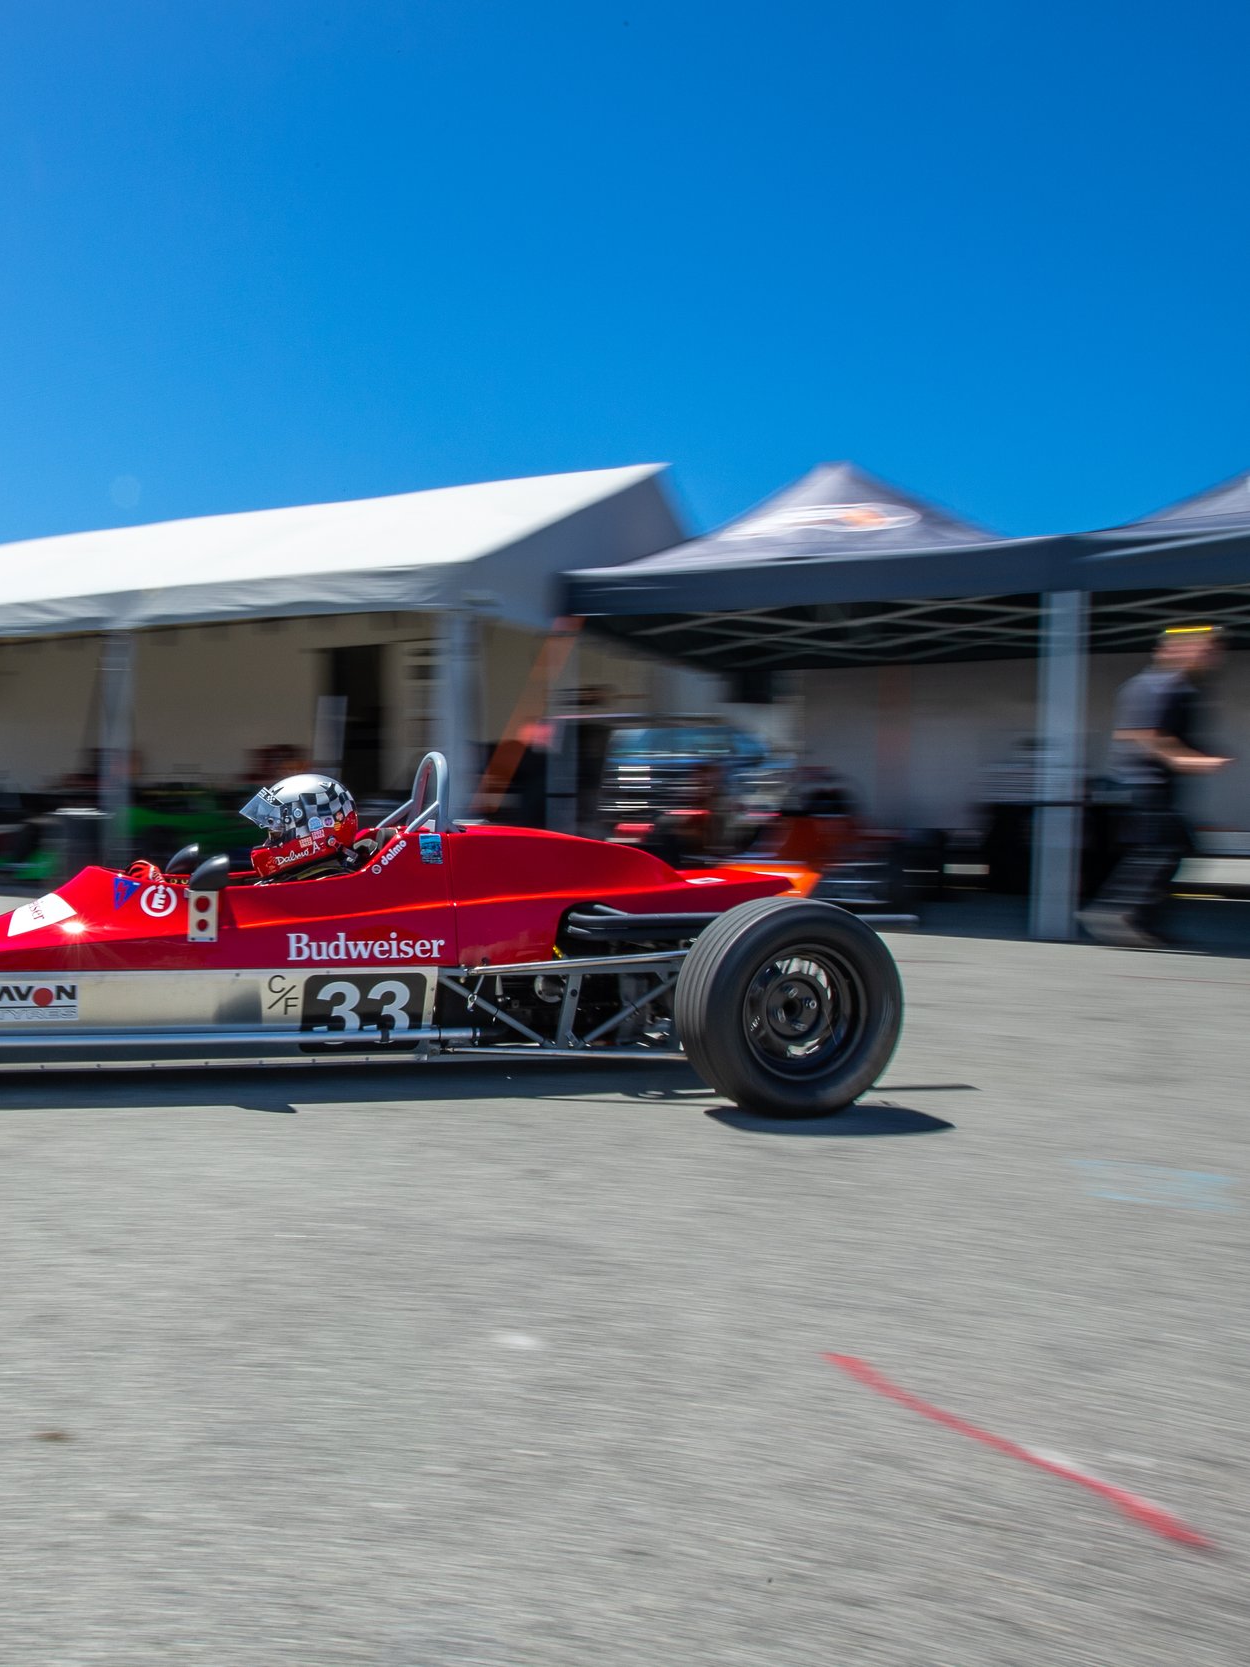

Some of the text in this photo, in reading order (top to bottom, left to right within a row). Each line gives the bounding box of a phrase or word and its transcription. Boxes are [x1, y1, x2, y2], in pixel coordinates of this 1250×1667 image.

[381, 840, 407, 866] dalmo
[286, 932, 445, 961] Budweiser
[312, 980, 411, 1045] 33
